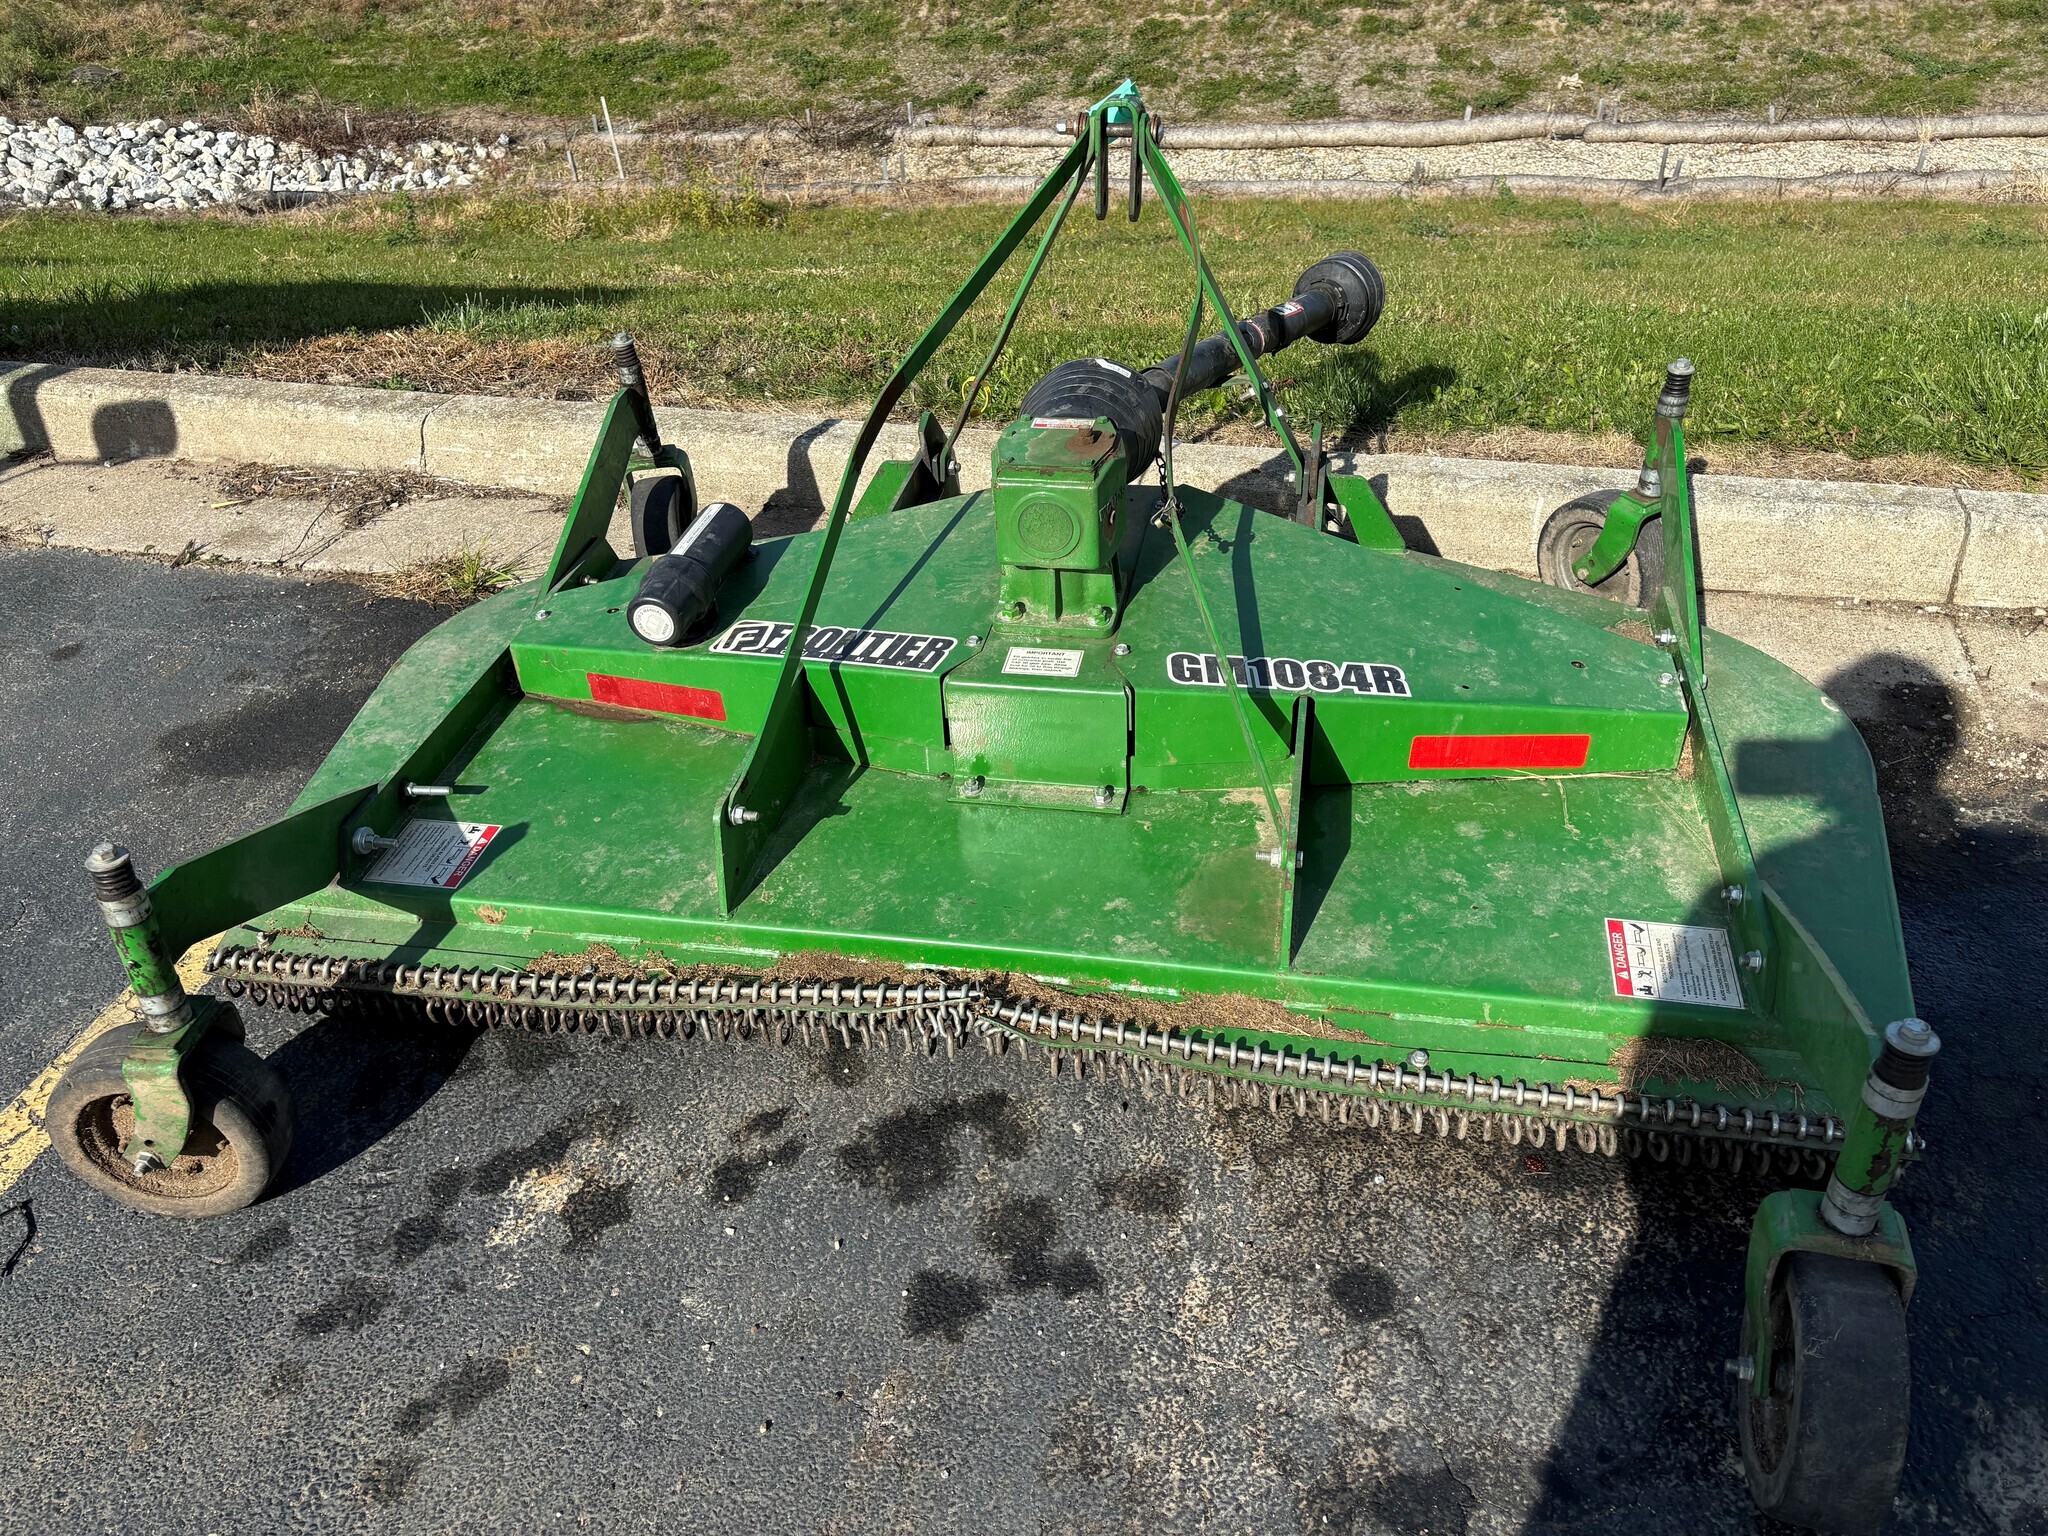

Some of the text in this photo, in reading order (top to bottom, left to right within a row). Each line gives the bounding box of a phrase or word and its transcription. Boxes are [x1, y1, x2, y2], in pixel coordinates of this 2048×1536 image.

[1169, 654, 1409, 695] GM1084R
[453, 846, 482, 876] DANGER
[1611, 931, 1626, 968] DANGER
